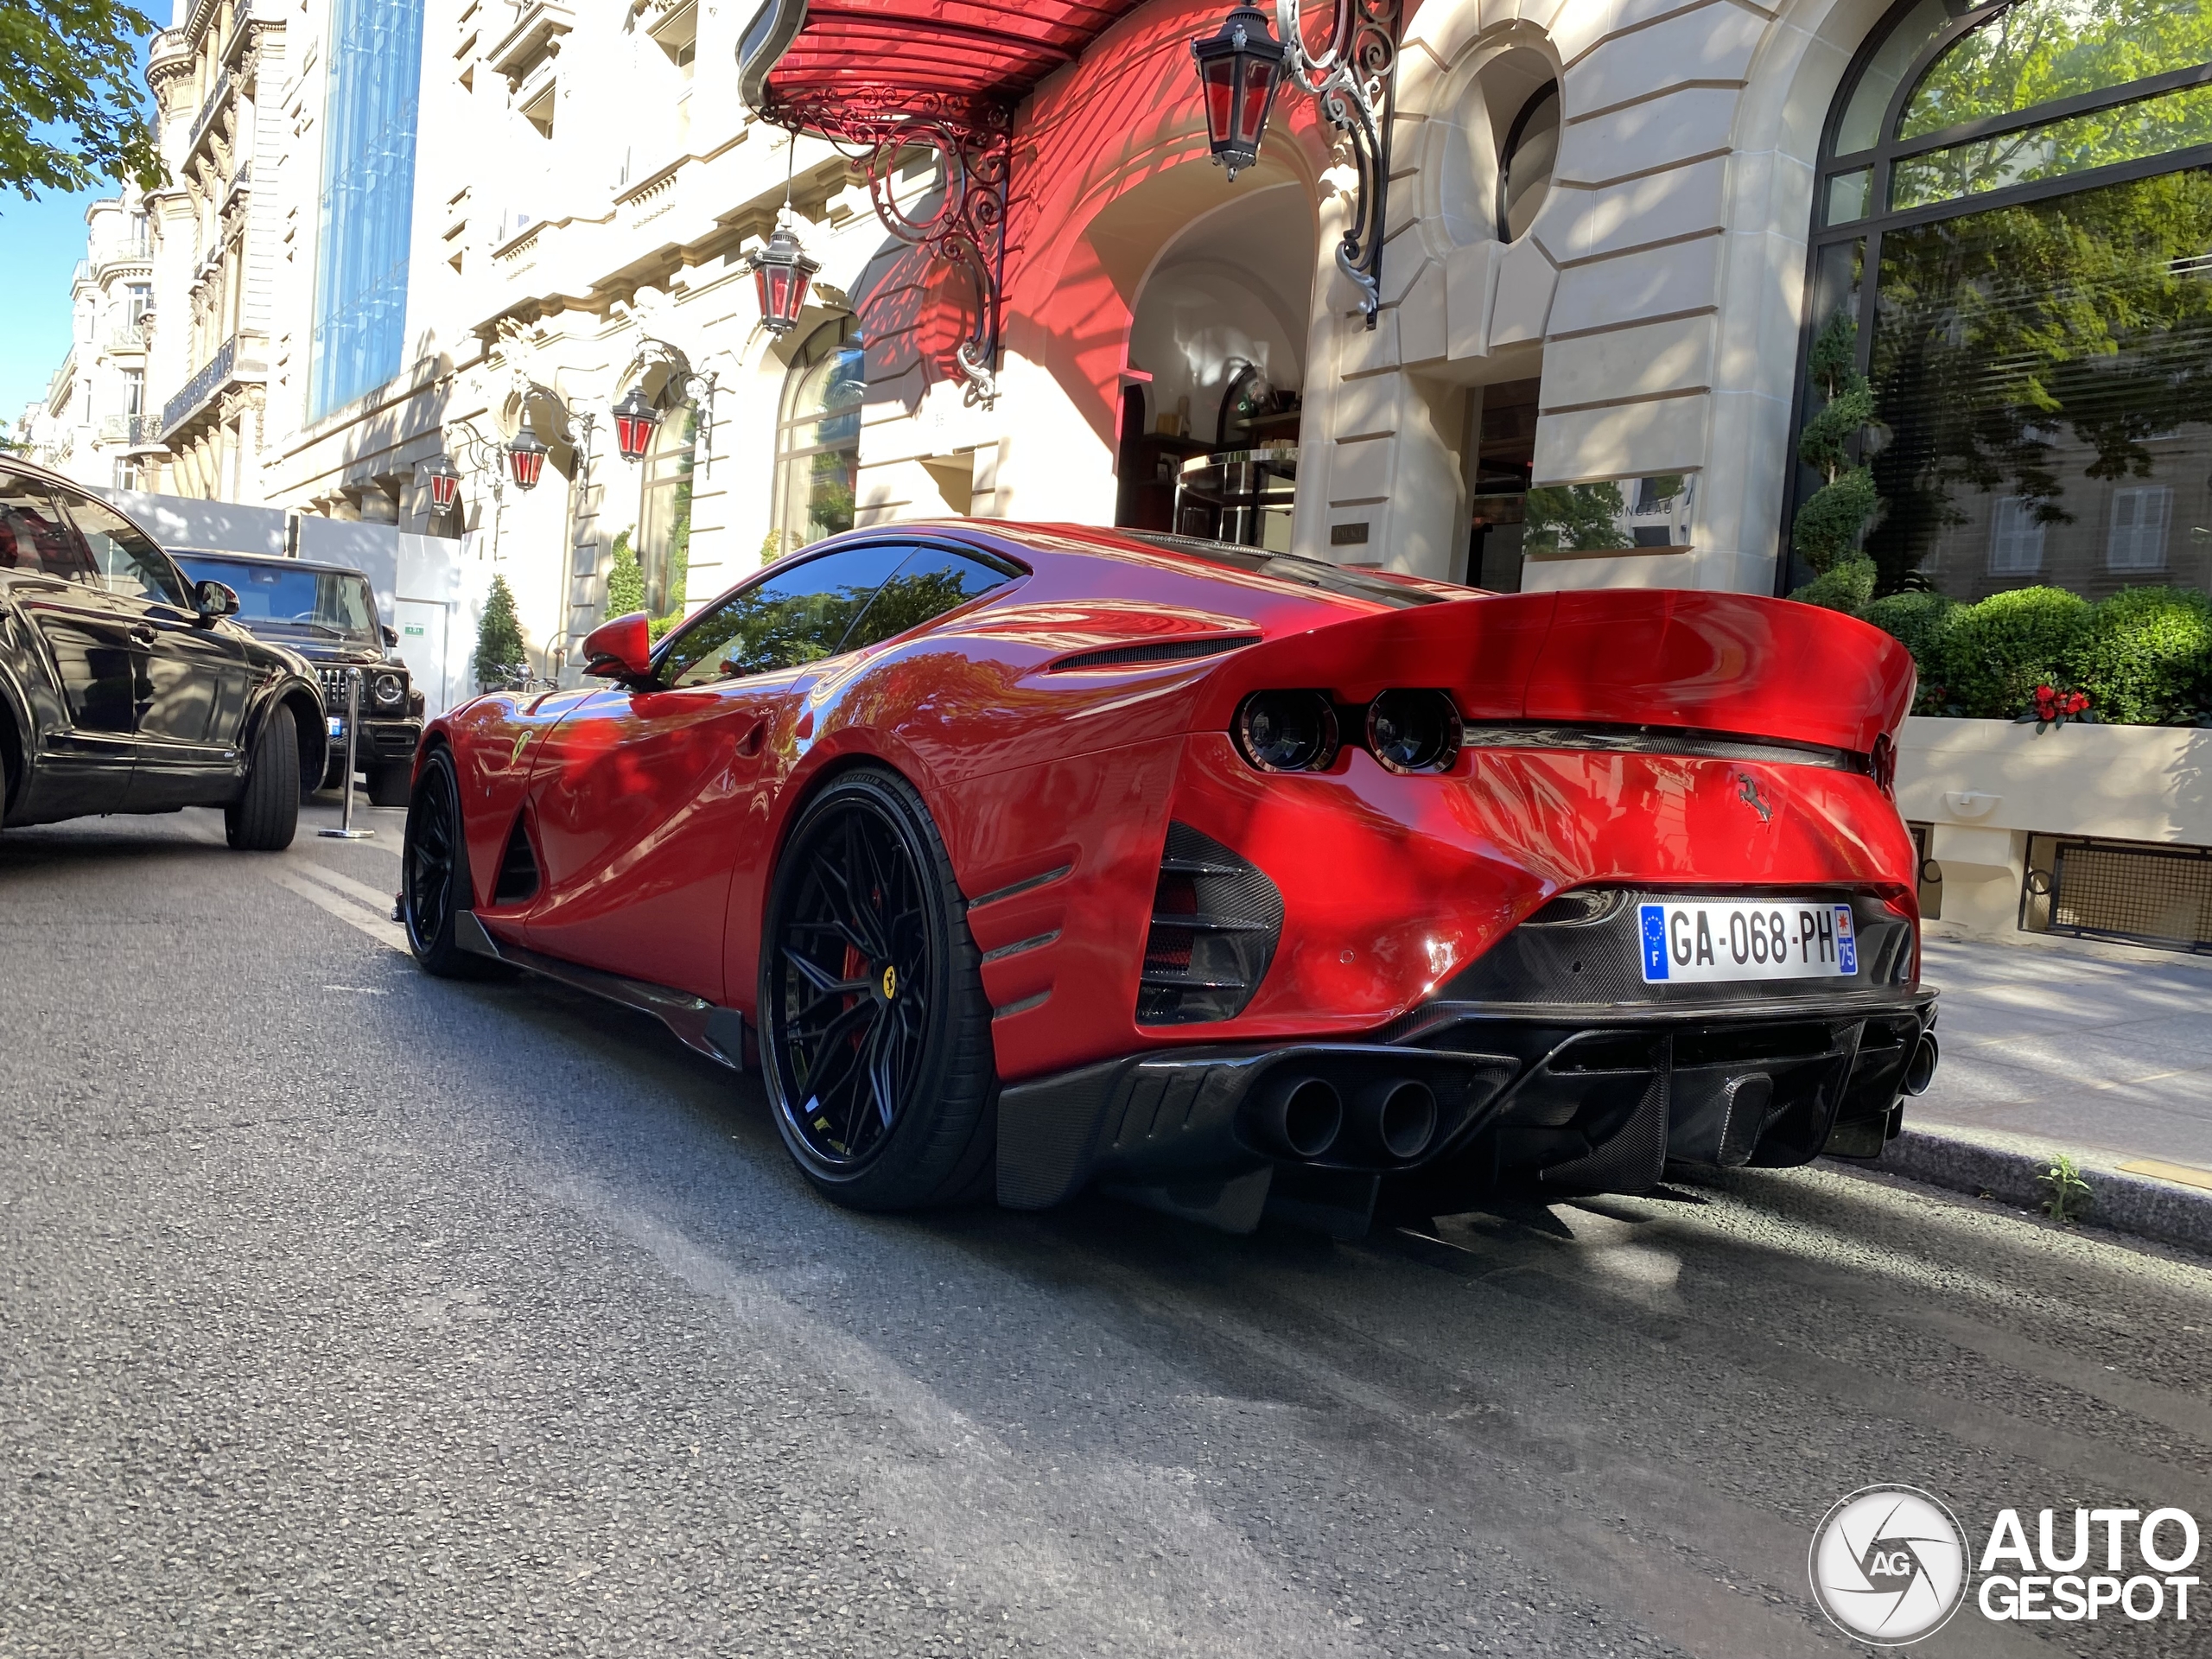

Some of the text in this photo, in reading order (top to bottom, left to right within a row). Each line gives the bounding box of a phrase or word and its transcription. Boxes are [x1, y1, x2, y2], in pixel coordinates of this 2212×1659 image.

[841, 773, 881, 785] MICHELIN
[1652, 910, 1854, 967] F GA-068-PH 75
